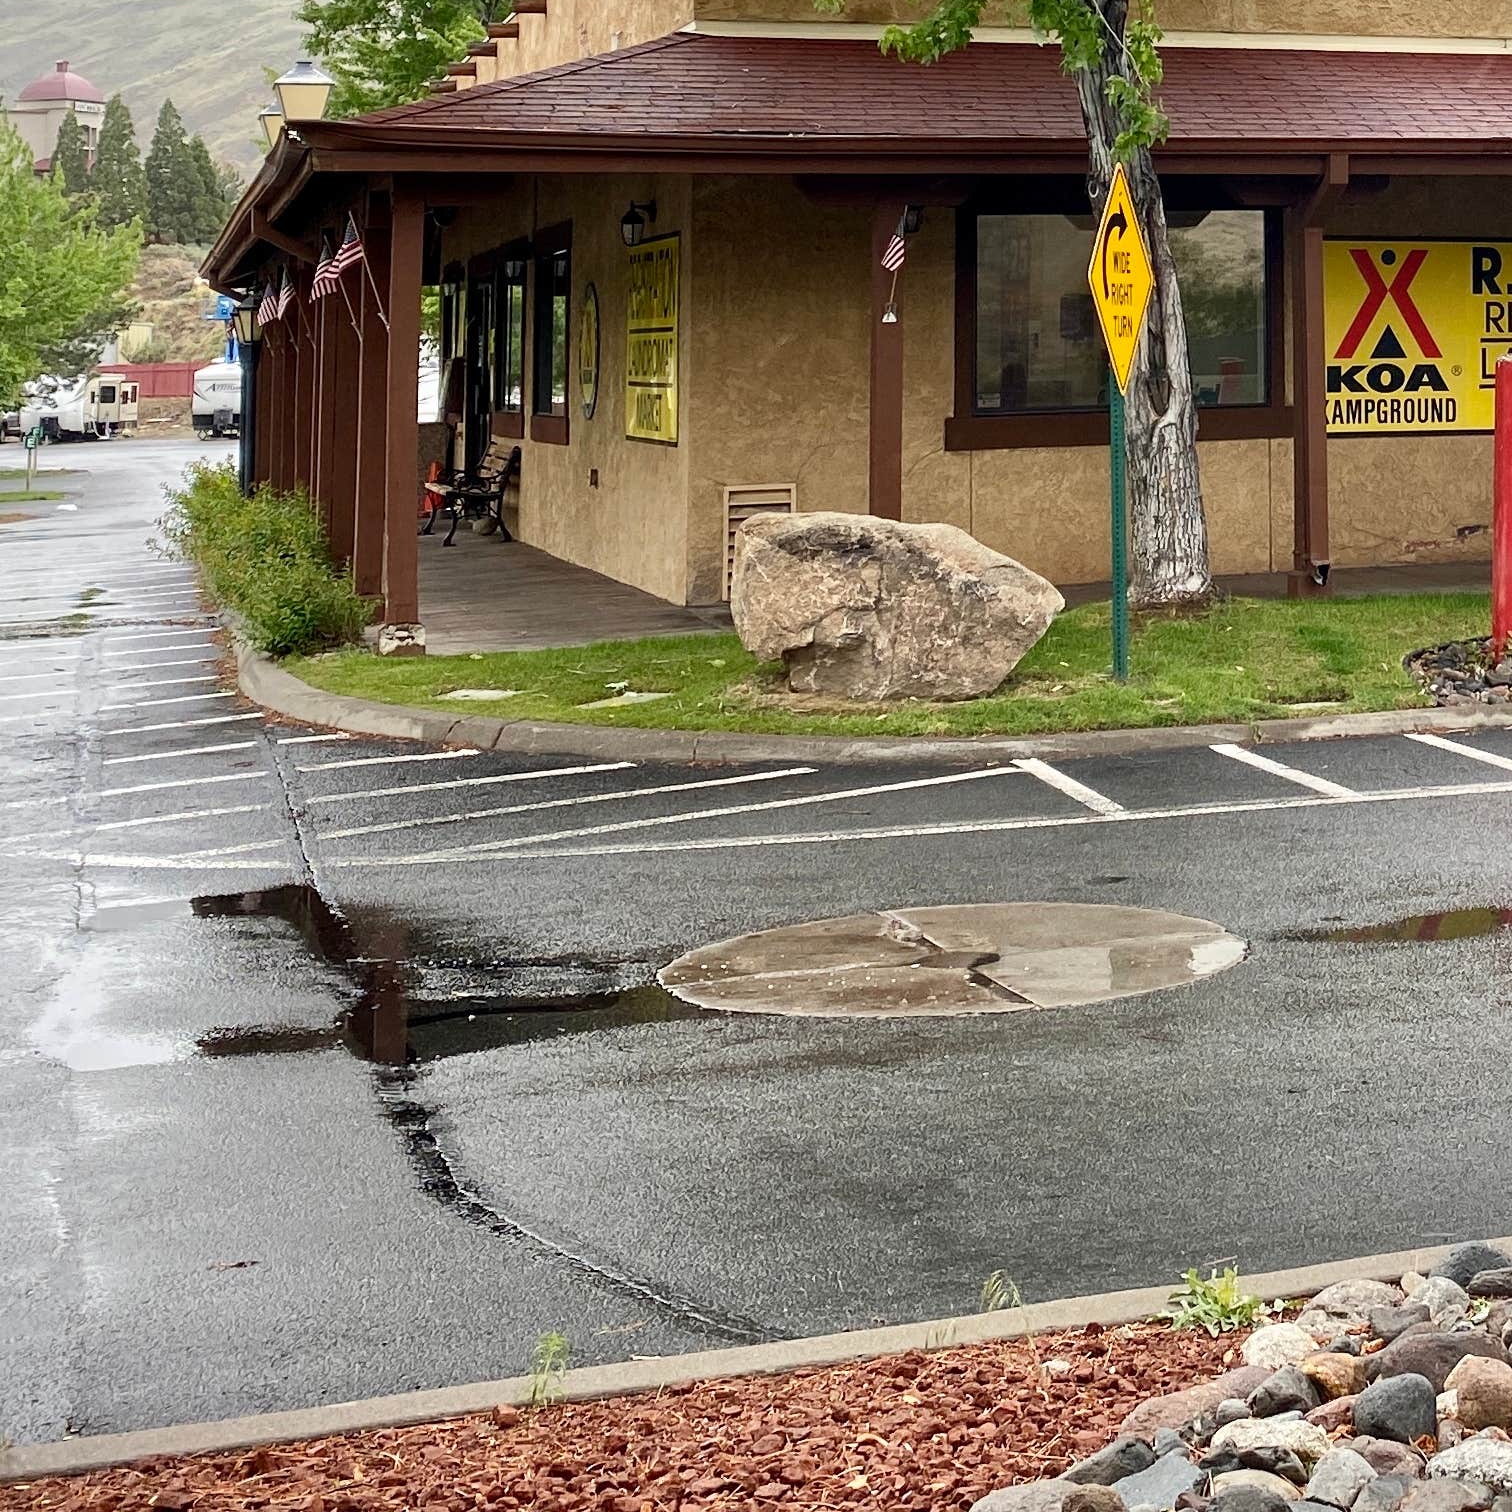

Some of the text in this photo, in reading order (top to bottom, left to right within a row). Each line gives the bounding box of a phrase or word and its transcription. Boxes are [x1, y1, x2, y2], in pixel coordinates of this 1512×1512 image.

[1112, 251, 1131, 274] WIDE
[1111, 283, 1133, 306] RIGHT
[1113, 315, 1133, 338] TURN
[1326, 363, 1450, 393] KOA
